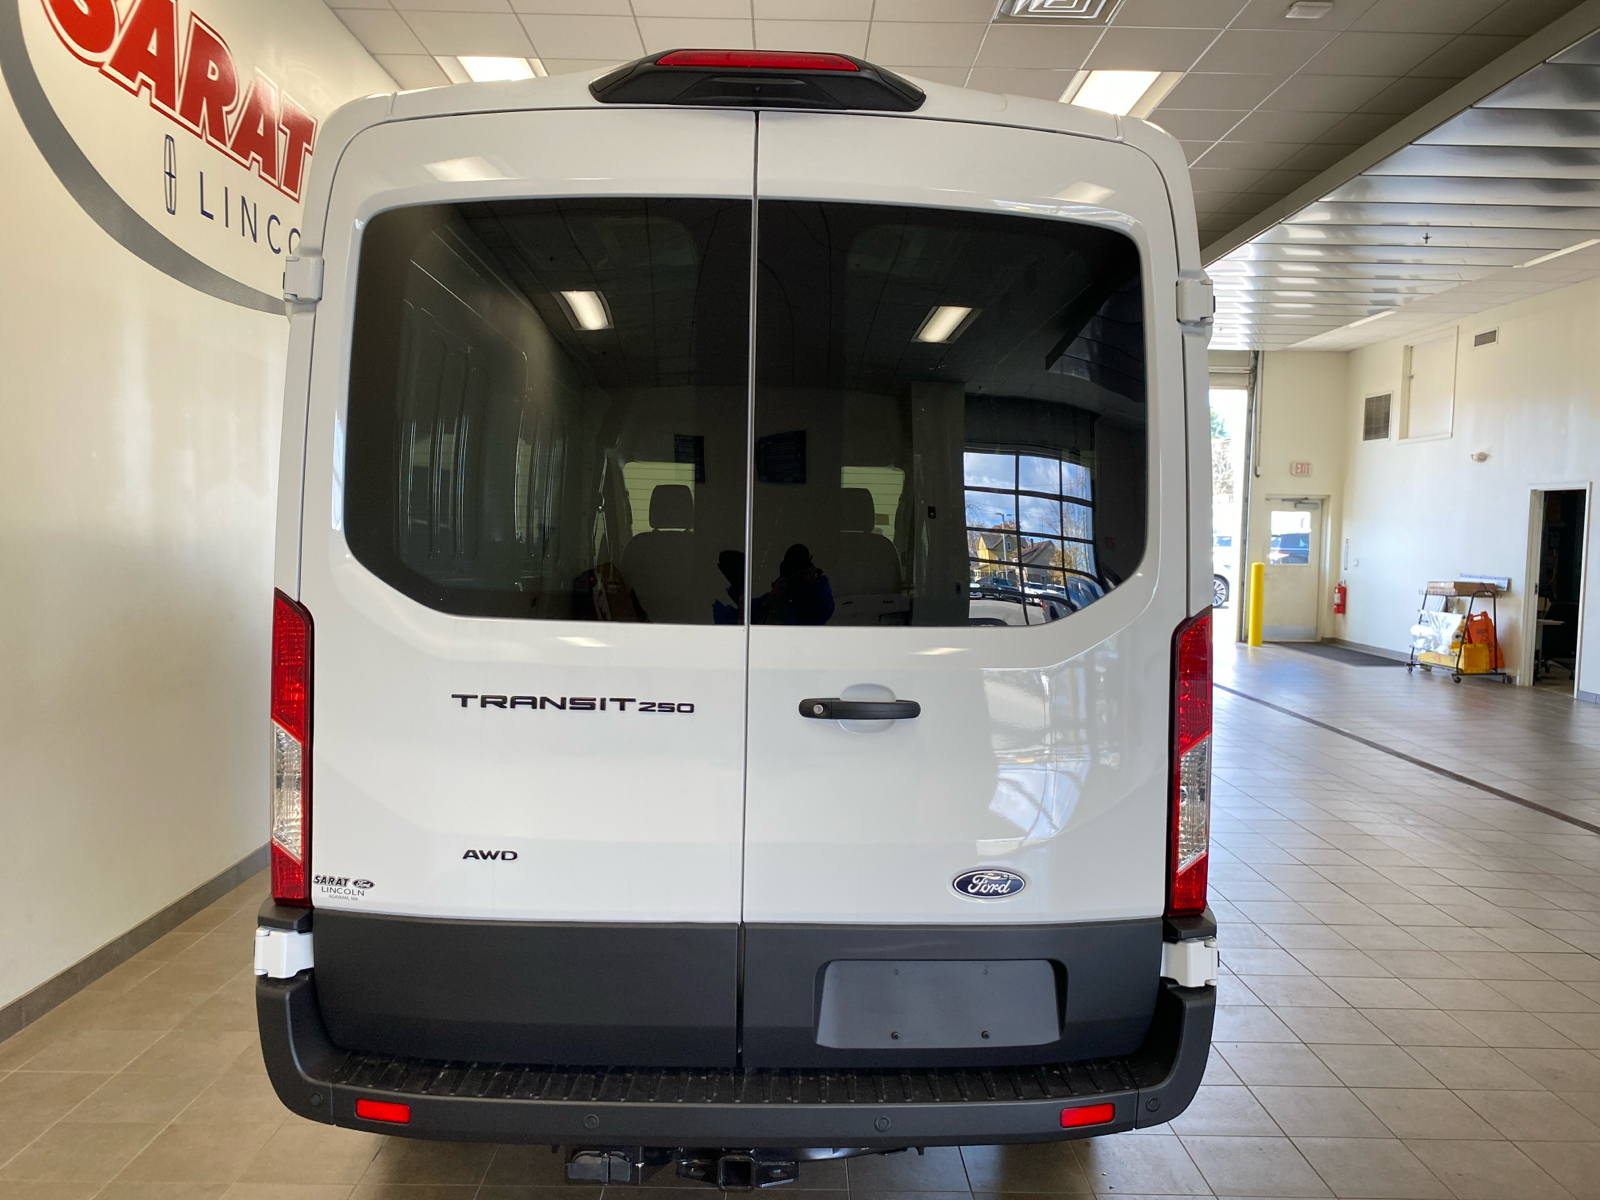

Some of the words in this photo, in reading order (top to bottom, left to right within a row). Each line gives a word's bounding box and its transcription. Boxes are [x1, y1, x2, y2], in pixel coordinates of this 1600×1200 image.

[1295, 462, 1310, 475] EXIT
[451, 694, 636, 711] TRANSIT
[638, 702, 695, 713] 250
[462, 849, 518, 861] AWD
[313, 875, 350, 887] SARAT
[967, 874, 1012, 894] Ford
[321, 886, 365, 896] LINCOLN
